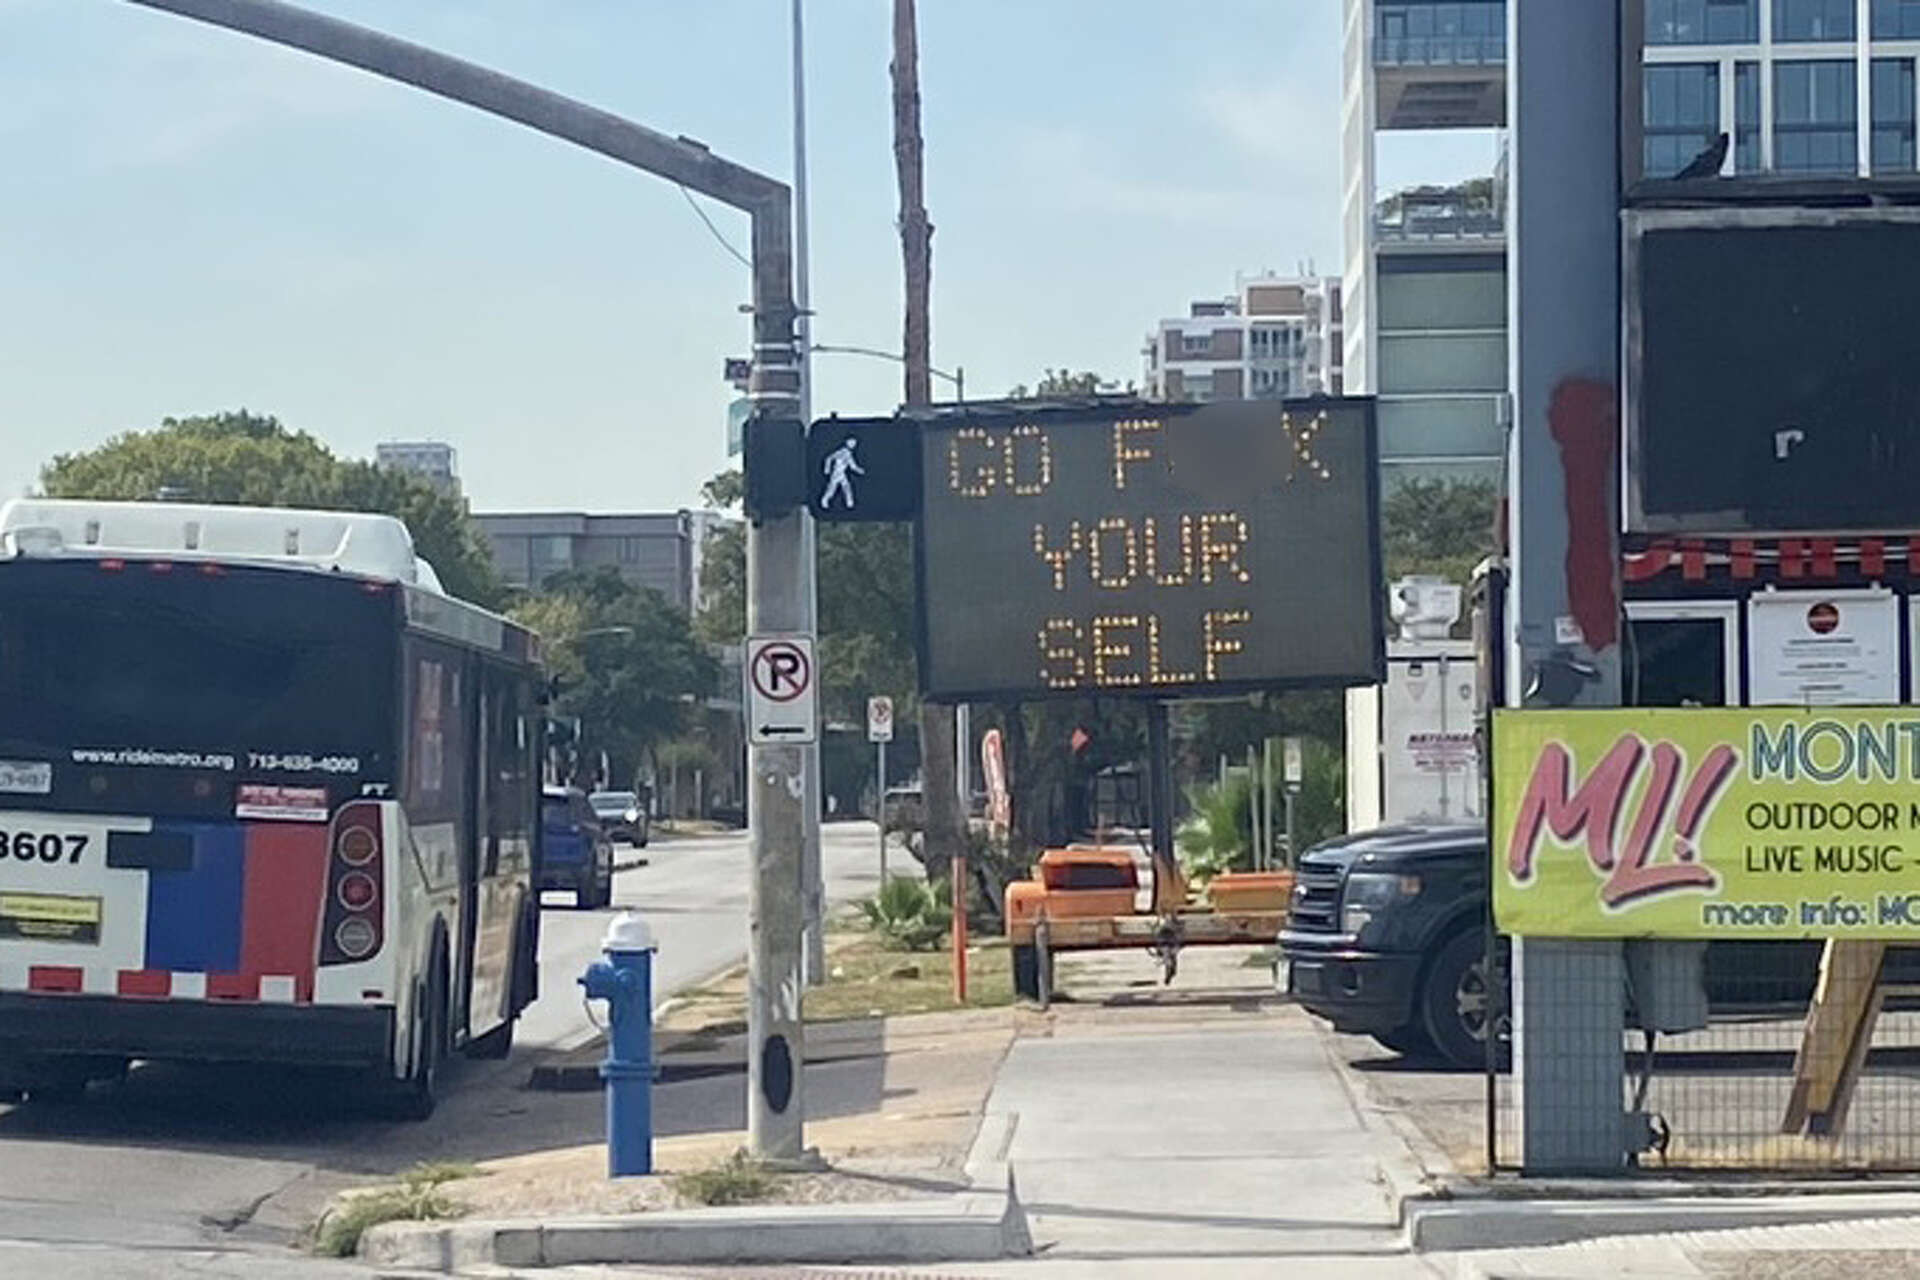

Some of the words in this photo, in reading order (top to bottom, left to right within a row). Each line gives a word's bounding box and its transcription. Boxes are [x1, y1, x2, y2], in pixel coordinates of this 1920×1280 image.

[949, 424, 1051, 496] GO
[1113, 409, 1331, 490] FK
[1034, 512, 1250, 590] YOUR
[1037, 609, 1251, 688] SELF
[1508, 732, 1738, 909] ML!
[1746, 803, 1899, 830] OUTDOOR
[1746, 846, 1804, 872] LIVE
[1814, 845, 1903, 873] MUSIC
[1702, 904, 1788, 925] more
